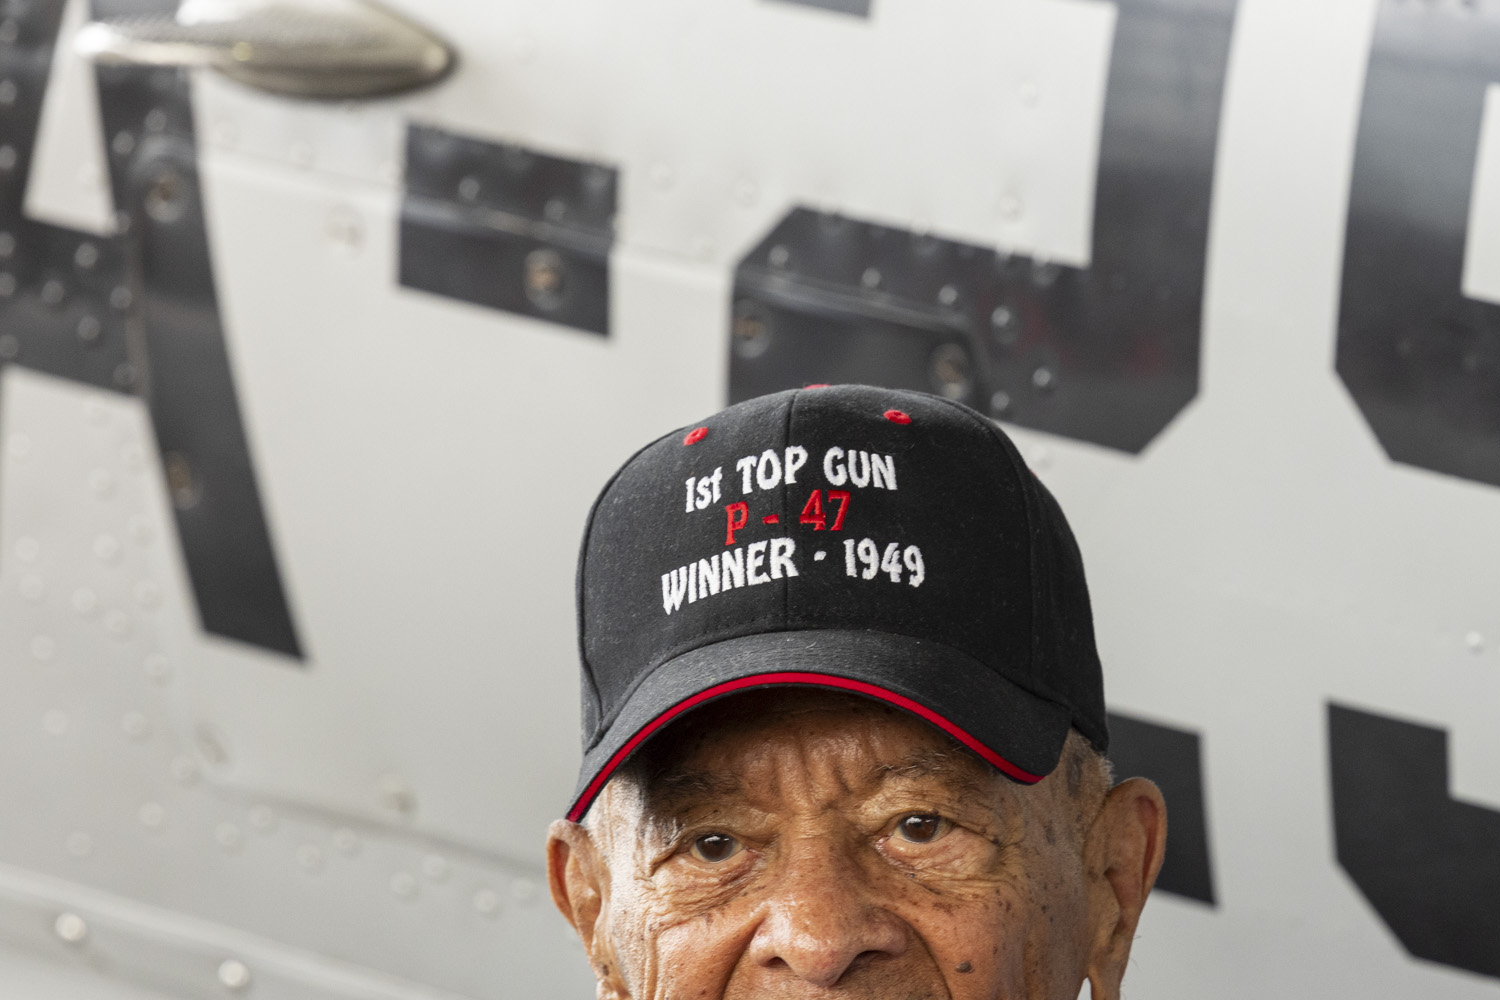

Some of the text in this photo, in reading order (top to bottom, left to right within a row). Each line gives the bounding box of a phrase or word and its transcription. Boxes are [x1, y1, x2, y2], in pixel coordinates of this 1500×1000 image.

[685, 445, 898, 513] 1st TOP GUN
[724, 501, 749, 546] P
[799, 489, 851, 532] 47
[661, 537, 799, 615] WINNER
[843, 537, 926, 588] 1949
